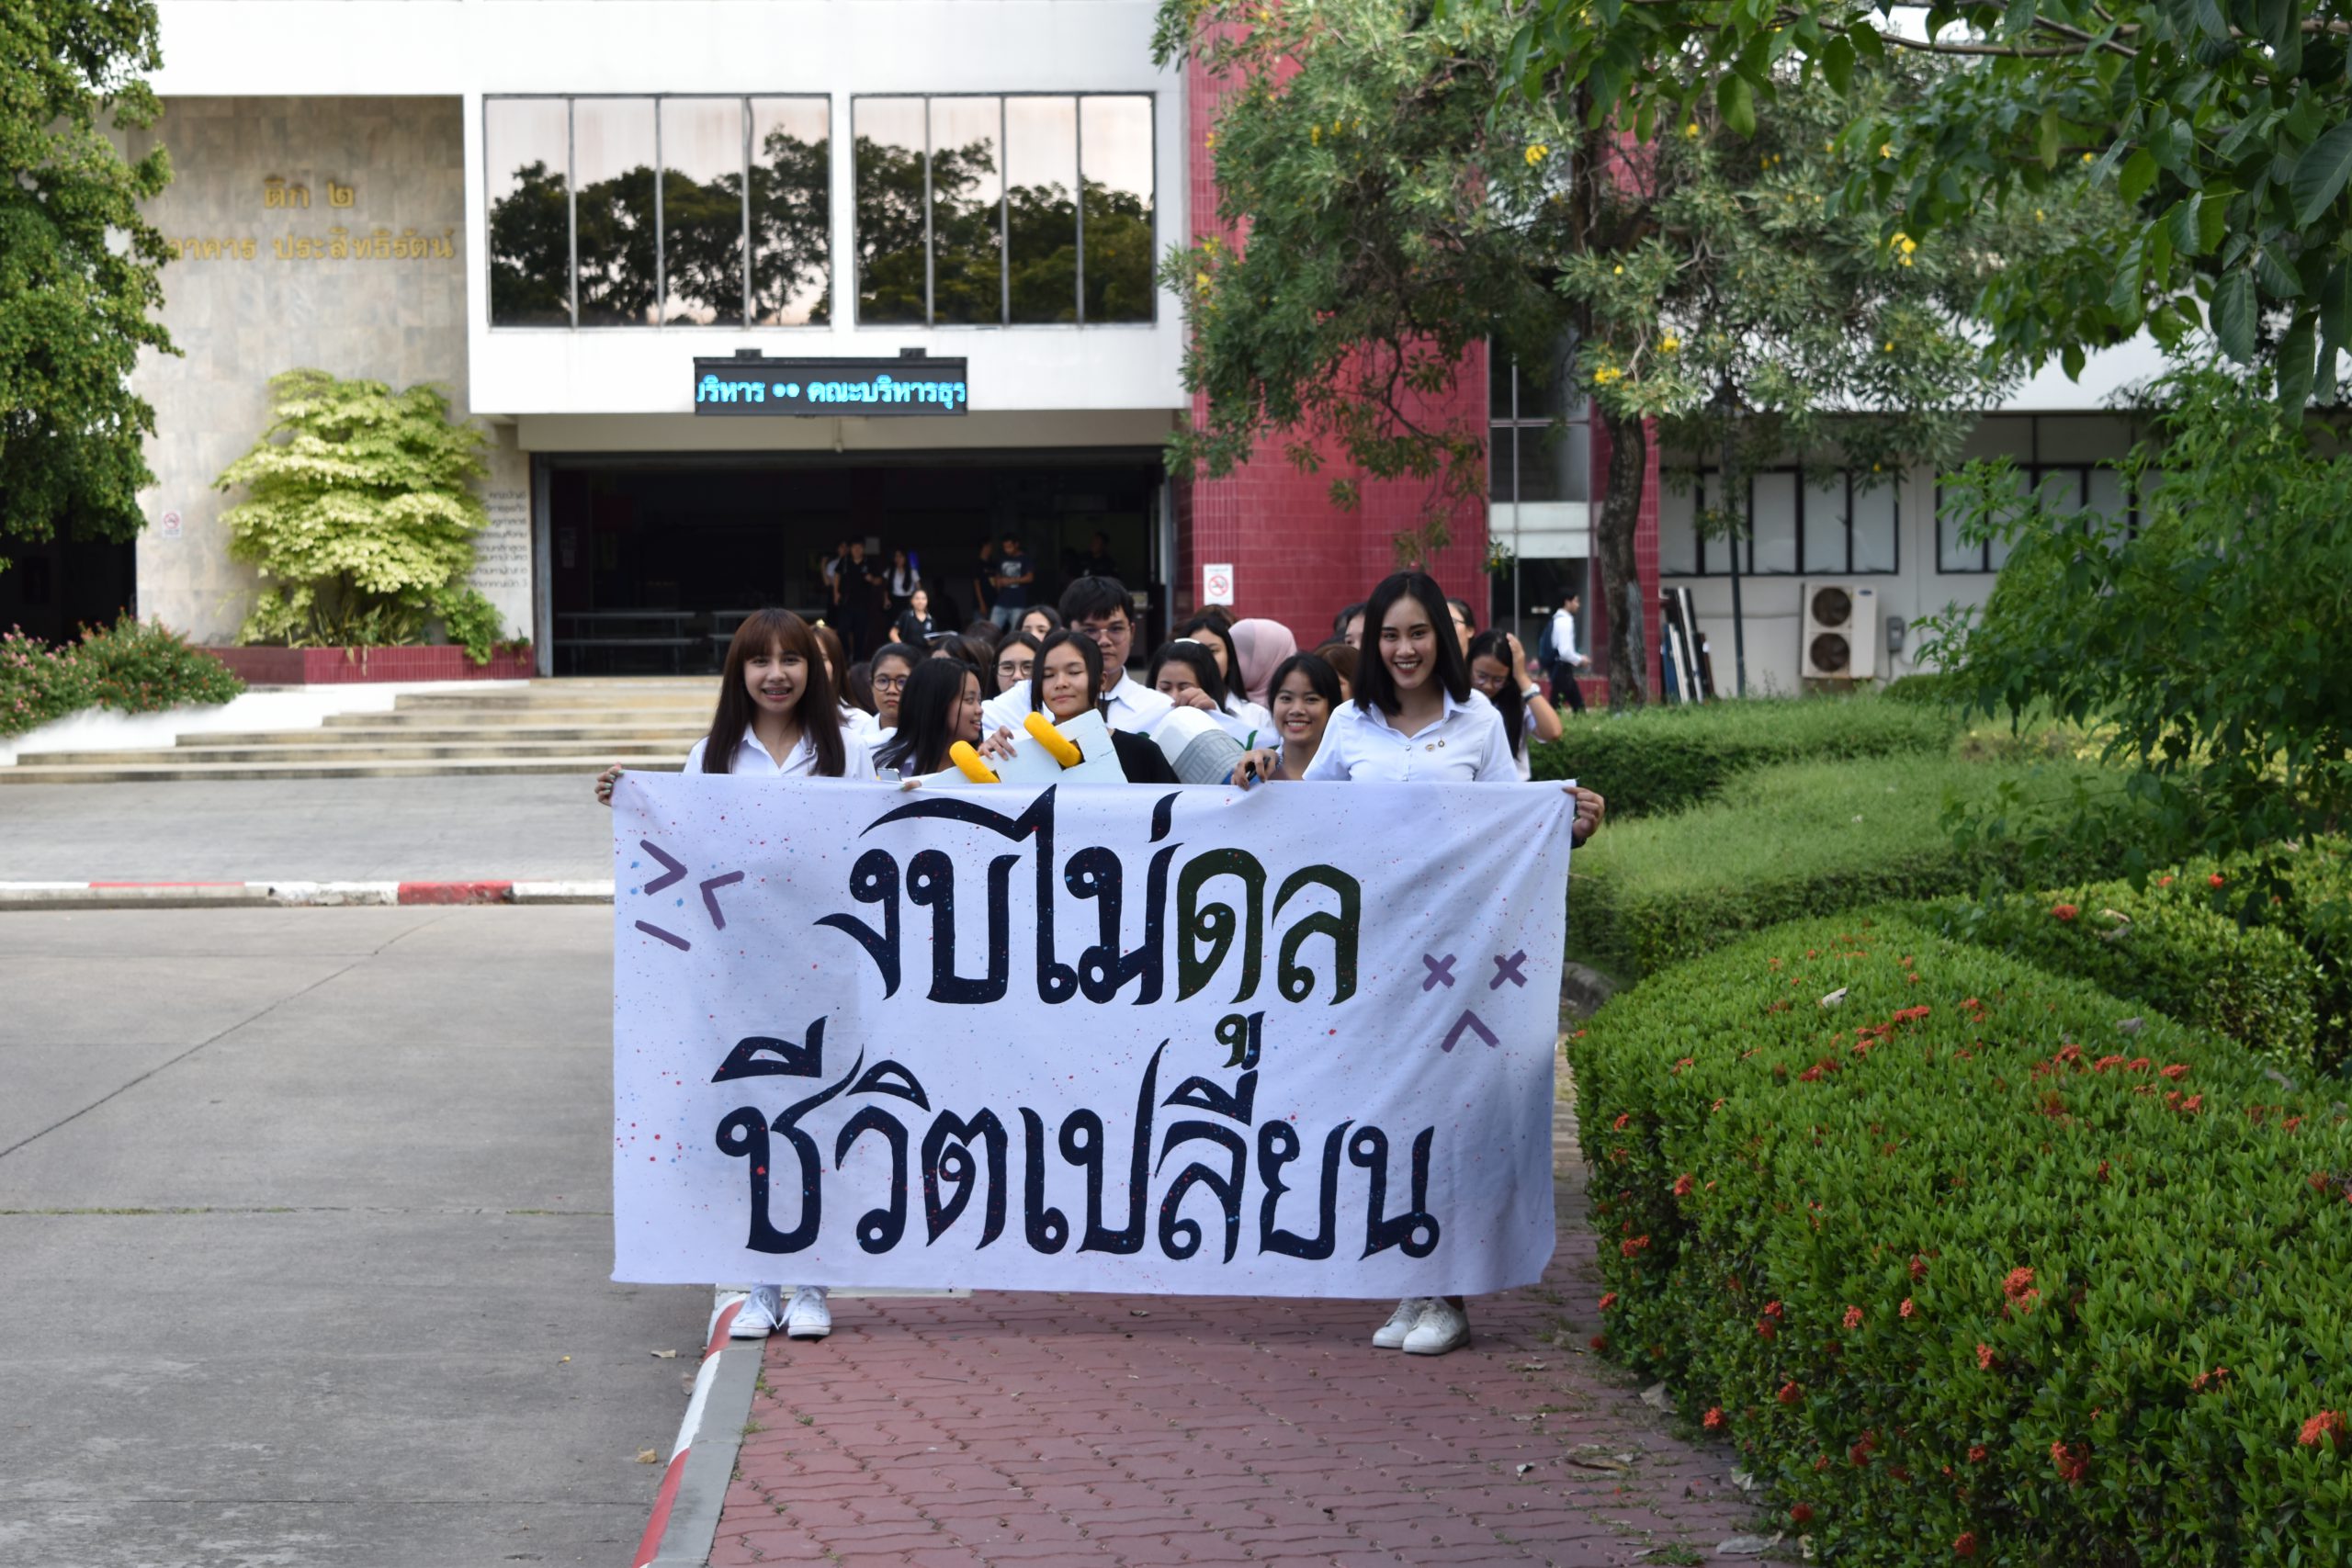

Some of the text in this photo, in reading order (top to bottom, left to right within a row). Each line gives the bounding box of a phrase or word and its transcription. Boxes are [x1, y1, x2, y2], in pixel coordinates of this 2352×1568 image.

[264, 175, 355, 209] ตึก ๒
[272, 227, 456, 260] ประสิทธิรัตน์
[813, 783, 1362, 1069] งบไม่ดุล
[711, 1010, 1442, 1263] ชีวิตเปลี่ยน
